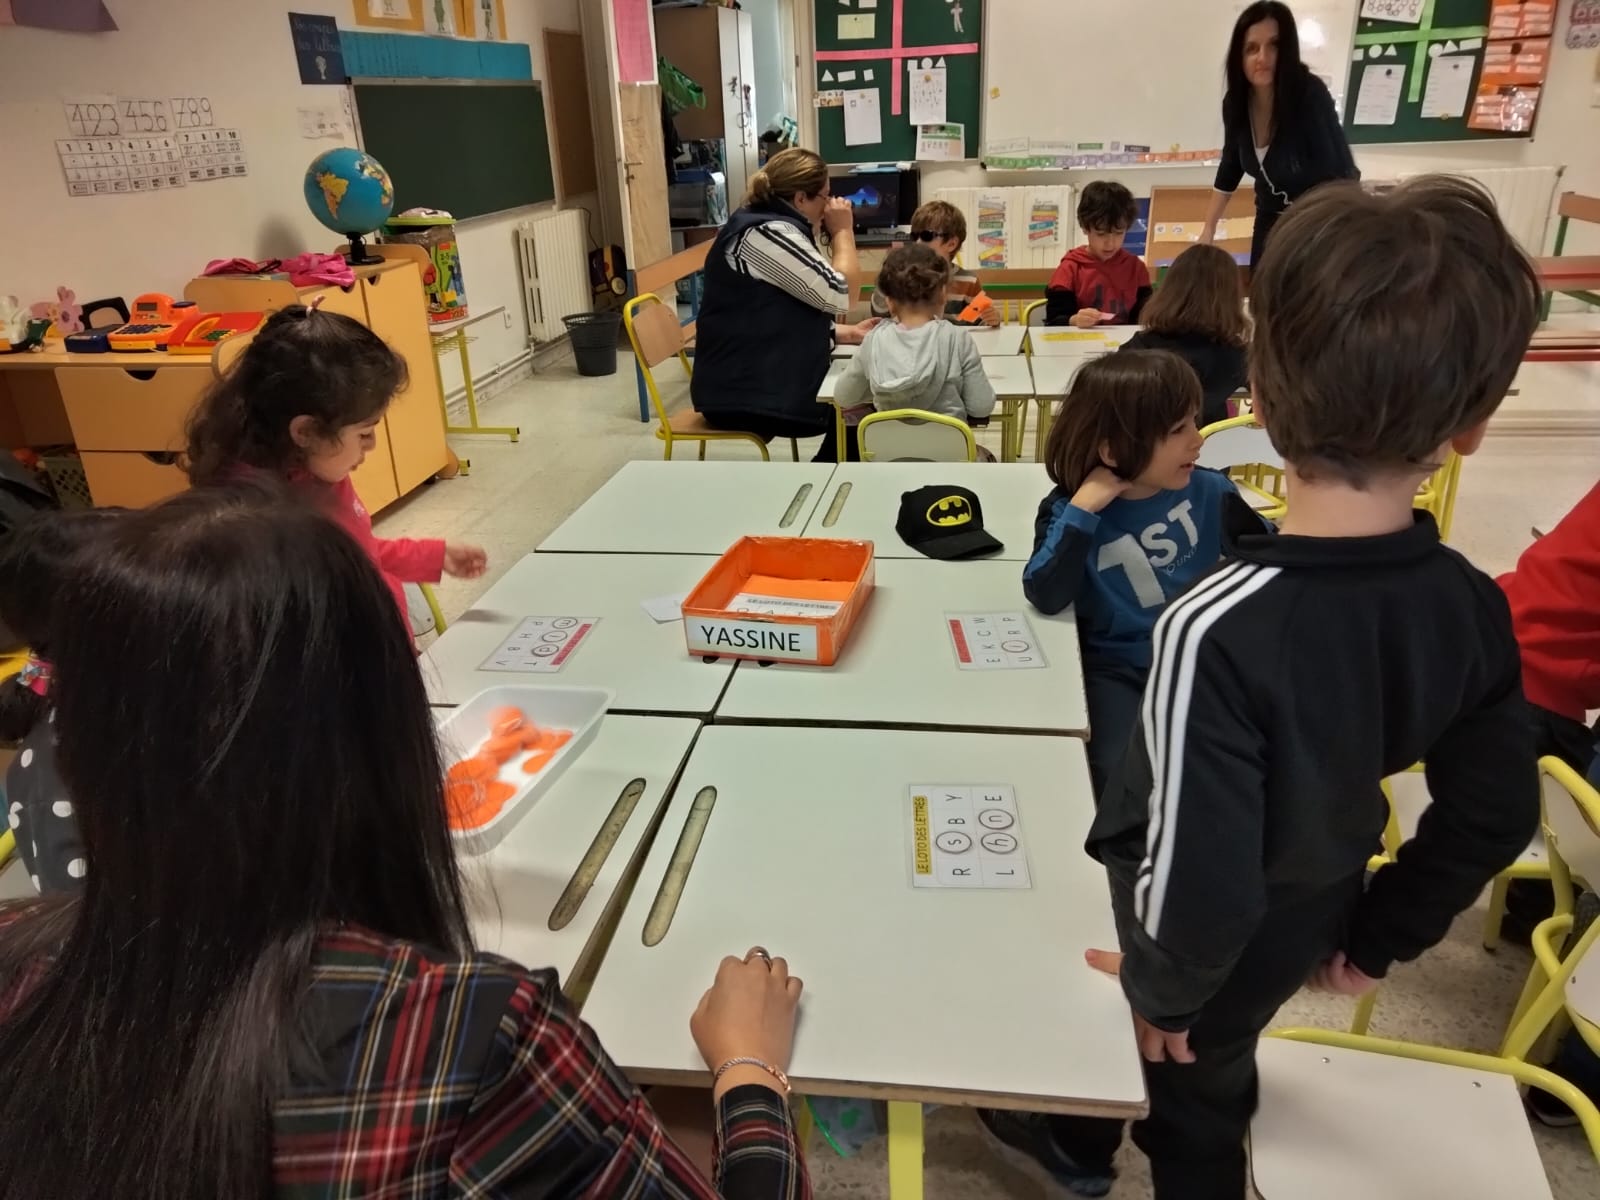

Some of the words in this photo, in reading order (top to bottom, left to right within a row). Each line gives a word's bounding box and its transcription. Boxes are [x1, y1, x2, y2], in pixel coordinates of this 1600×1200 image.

[125, 101, 168, 132] 456
[701, 625, 801, 652] YASSINE
[945, 794, 963, 802] Y
[914, 796, 927, 826] LETTRES
[947, 817, 966, 825] B
[988, 815, 1002, 823] n
[916, 827, 928, 841] DES
[986, 838, 1009, 847] h
[917, 842, 929, 863] LOTO
[918, 864, 929, 874] LE
[952, 868, 972, 876] R
